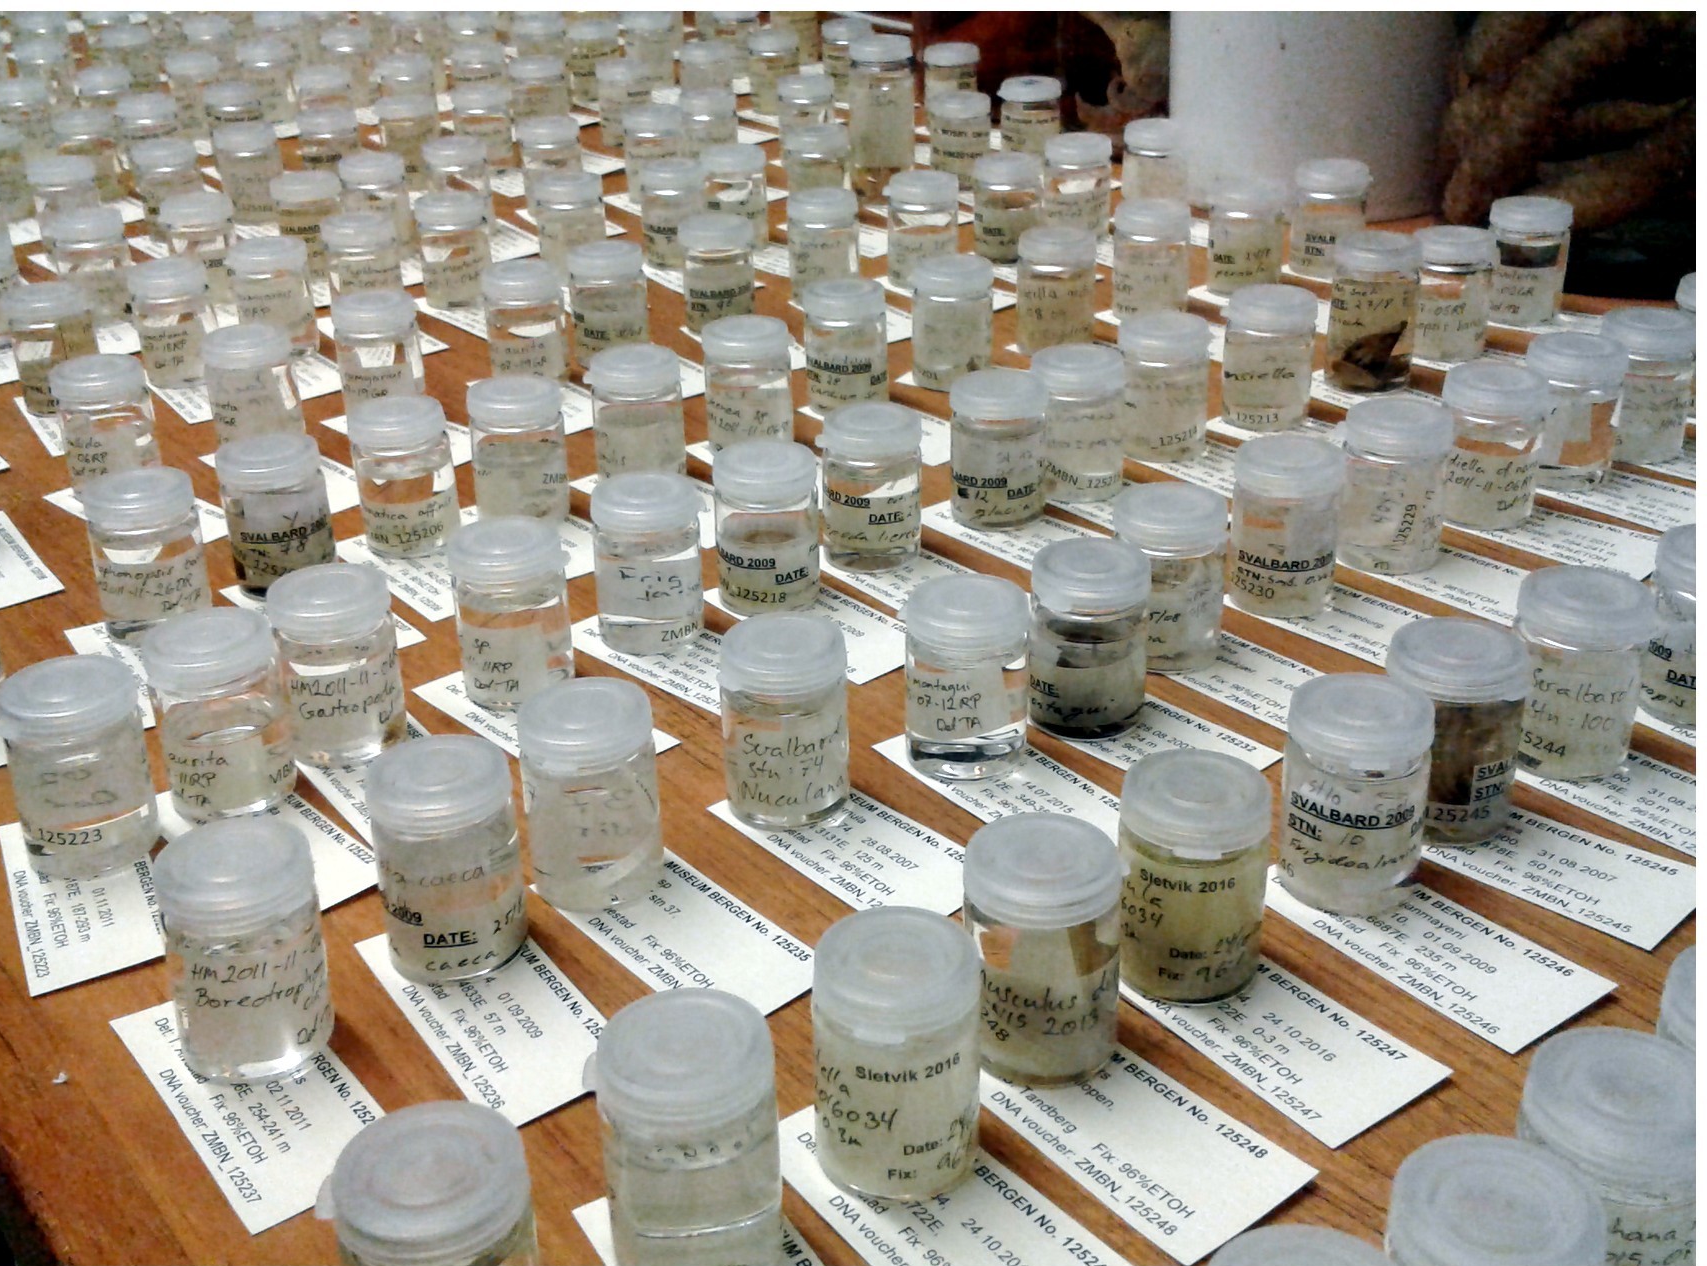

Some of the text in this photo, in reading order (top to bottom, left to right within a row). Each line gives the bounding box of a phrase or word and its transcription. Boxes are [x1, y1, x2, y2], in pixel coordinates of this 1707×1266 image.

[240, 526, 307, 543] SVALBARD
[747, 557, 776, 569] 2009
[1238, 549, 1310, 570] SVALBARD
[775, 566, 809, 586] DATE:
[299, 805, 338, 835] BERGEN
[1290, 791, 1381, 828] SVALBARD
[38, 828, 102, 846] 125223
[876, 810, 942, 850] BERGEN No.
[1288, 813, 1323, 842] STN:
[1527, 817, 1591, 847] BERGEN
[1593, 840, 1617, 856] No.
[766, 833, 791, 851] DNA
[1425, 844, 1459, 864] DNA
[13, 869, 27, 891] DNA
[134, 860, 155, 895] BERGEN
[1198, 877, 1236, 894] 2016
[663, 859, 812, 963] MUSEUM BERGEN No. 125235
[422, 930, 478, 948] DATE:
[587, 916, 611, 937] DNA
[1312, 918, 1343, 941] DNA
[1430, 898, 1574, 978] BERGEN No. 125246
[401, 984, 422, 1008] DNA
[535, 963, 582, 1019] BERGEN No.
[1267, 970, 1409, 1062] BERGEN No. 125247
[159, 1068, 177, 1094] DNA
[854, 1053, 961, 1084] Sletvik 2016
[990, 1090, 1021, 1118] DNA
[1018, 1083, 1079, 1135] Tandberg
[1123, 1061, 1270, 1160] BERGEN No. 125248
[902, 1138, 943, 1157] Date:
[887, 1168, 918, 1181] Fix:
[974, 1165, 1059, 1237] BERGEN No.
